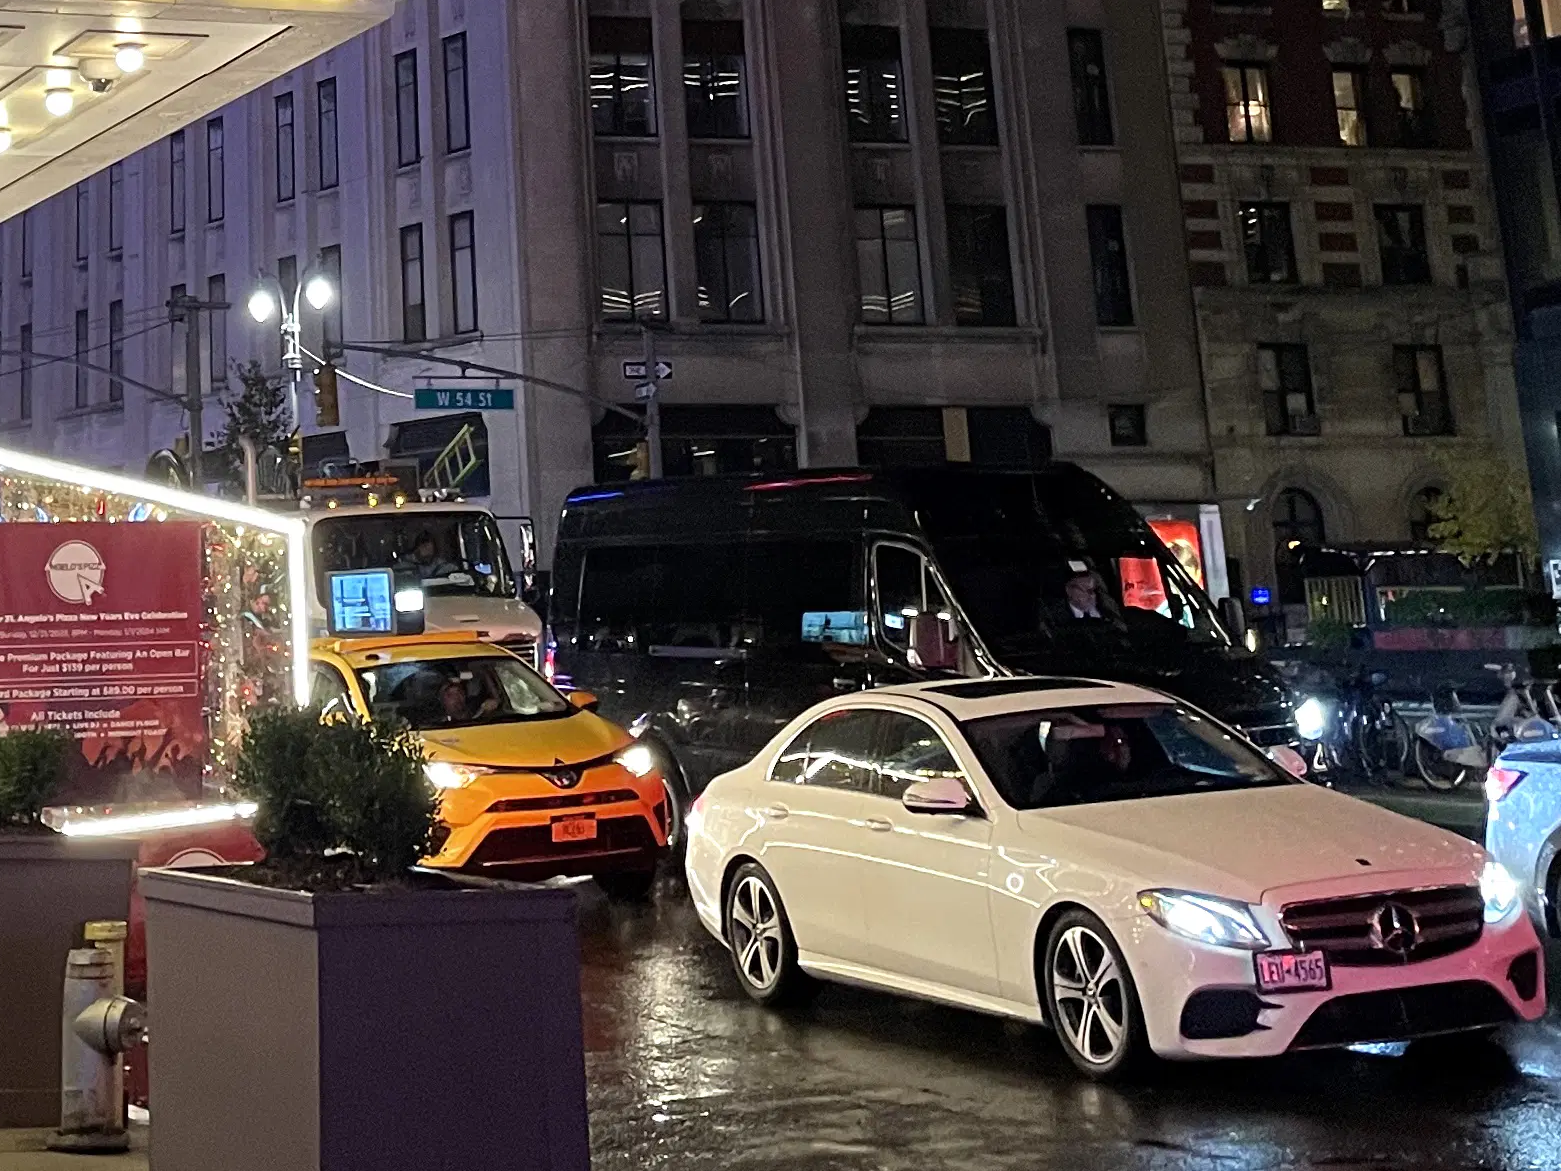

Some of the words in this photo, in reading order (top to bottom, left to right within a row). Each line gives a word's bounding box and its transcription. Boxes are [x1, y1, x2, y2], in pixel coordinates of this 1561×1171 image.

[437, 391, 450, 406] W
[456, 392, 472, 407] 54
[479, 392, 492, 407] St
[124, 611, 140, 620] Eve
[7, 653, 48, 663] Premium
[49, 652, 88, 662] Package
[90, 651, 133, 661] Featuring
[135, 650, 148, 658] An
[149, 649, 173, 659] Open
[22, 664, 39, 673] For
[40, 663, 60, 672] Just
[84, 663, 100, 672] per
[102, 662, 134, 672] person
[12, 689, 51, 699] Package
[52, 687, 90, 697] Starting
[91, 687, 101, 695] at
[136, 686, 152, 695] per
[153, 685, 184, 694] person
[47, 710, 83, 720] Tickets
[84, 709, 121, 719] Include
